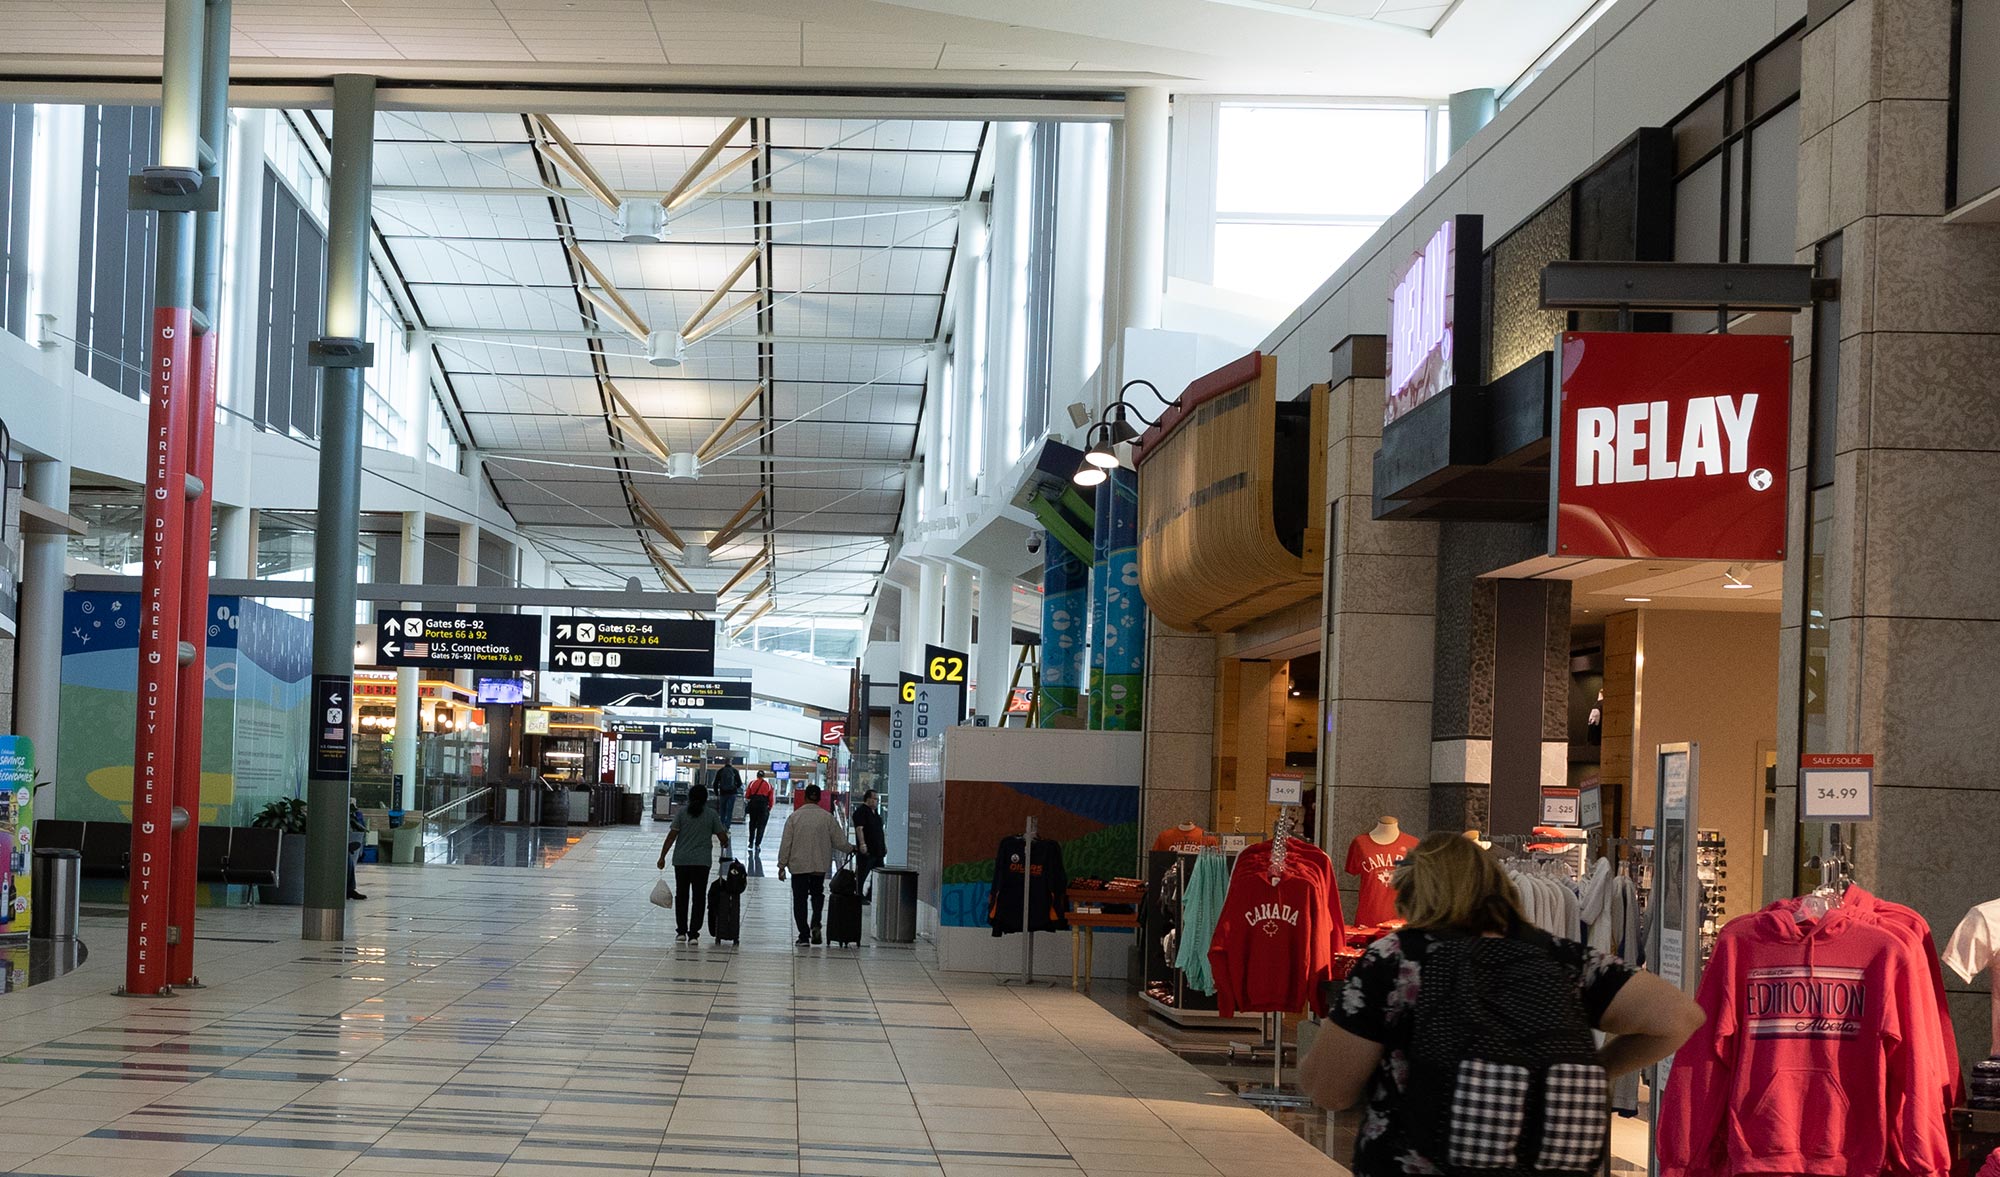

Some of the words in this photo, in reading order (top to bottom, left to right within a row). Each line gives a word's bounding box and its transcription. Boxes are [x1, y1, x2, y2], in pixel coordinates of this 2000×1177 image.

[1391, 220, 1451, 396] RELAY
[160, 358, 172, 409] DUTY
[1576, 393, 1759, 487] RELAY
[158, 427, 168, 479] FREE
[154, 518, 165, 570] DUTY
[151, 588, 161, 640] FREE
[425, 619, 452, 629] Gates
[454, 620, 484, 630] 66-92
[425, 630, 453, 639] Portes
[455, 630, 467, 639] 66
[468, 630, 474, 640] à
[476, 631, 488, 640] 92
[598, 624, 624, 633] Gates
[625, 624, 653, 634] 62-64
[432, 642, 449, 652] U.S.
[452, 643, 510, 654] Connections
[598, 635, 626, 644] Portes
[627, 636, 638, 644] 62
[640, 636, 646, 644] à
[648, 636, 659, 645] 64
[431, 652, 450, 660] Gates
[514, 654, 523, 662] 92
[930, 656, 964, 682] 62
[902, 682, 916, 702] 6
[148, 682, 158, 734] DUTY
[1812, 757, 1862, 765] SALE/SOLDE
[146, 752, 154, 804] FREE
[1818, 788, 1858, 799] 34.99
[1558, 805, 1574, 814] $25
[1009, 863, 1043, 872] OILRS
[1361, 853, 1404, 873] CANA
[142, 853, 151, 904] DUTY
[1244, 903, 1299, 926] CANADA
[139, 923, 147, 974] FREE
[1747, 980, 1866, 1017] EDMONTON
[1795, 1018, 1856, 1032] Alberta
